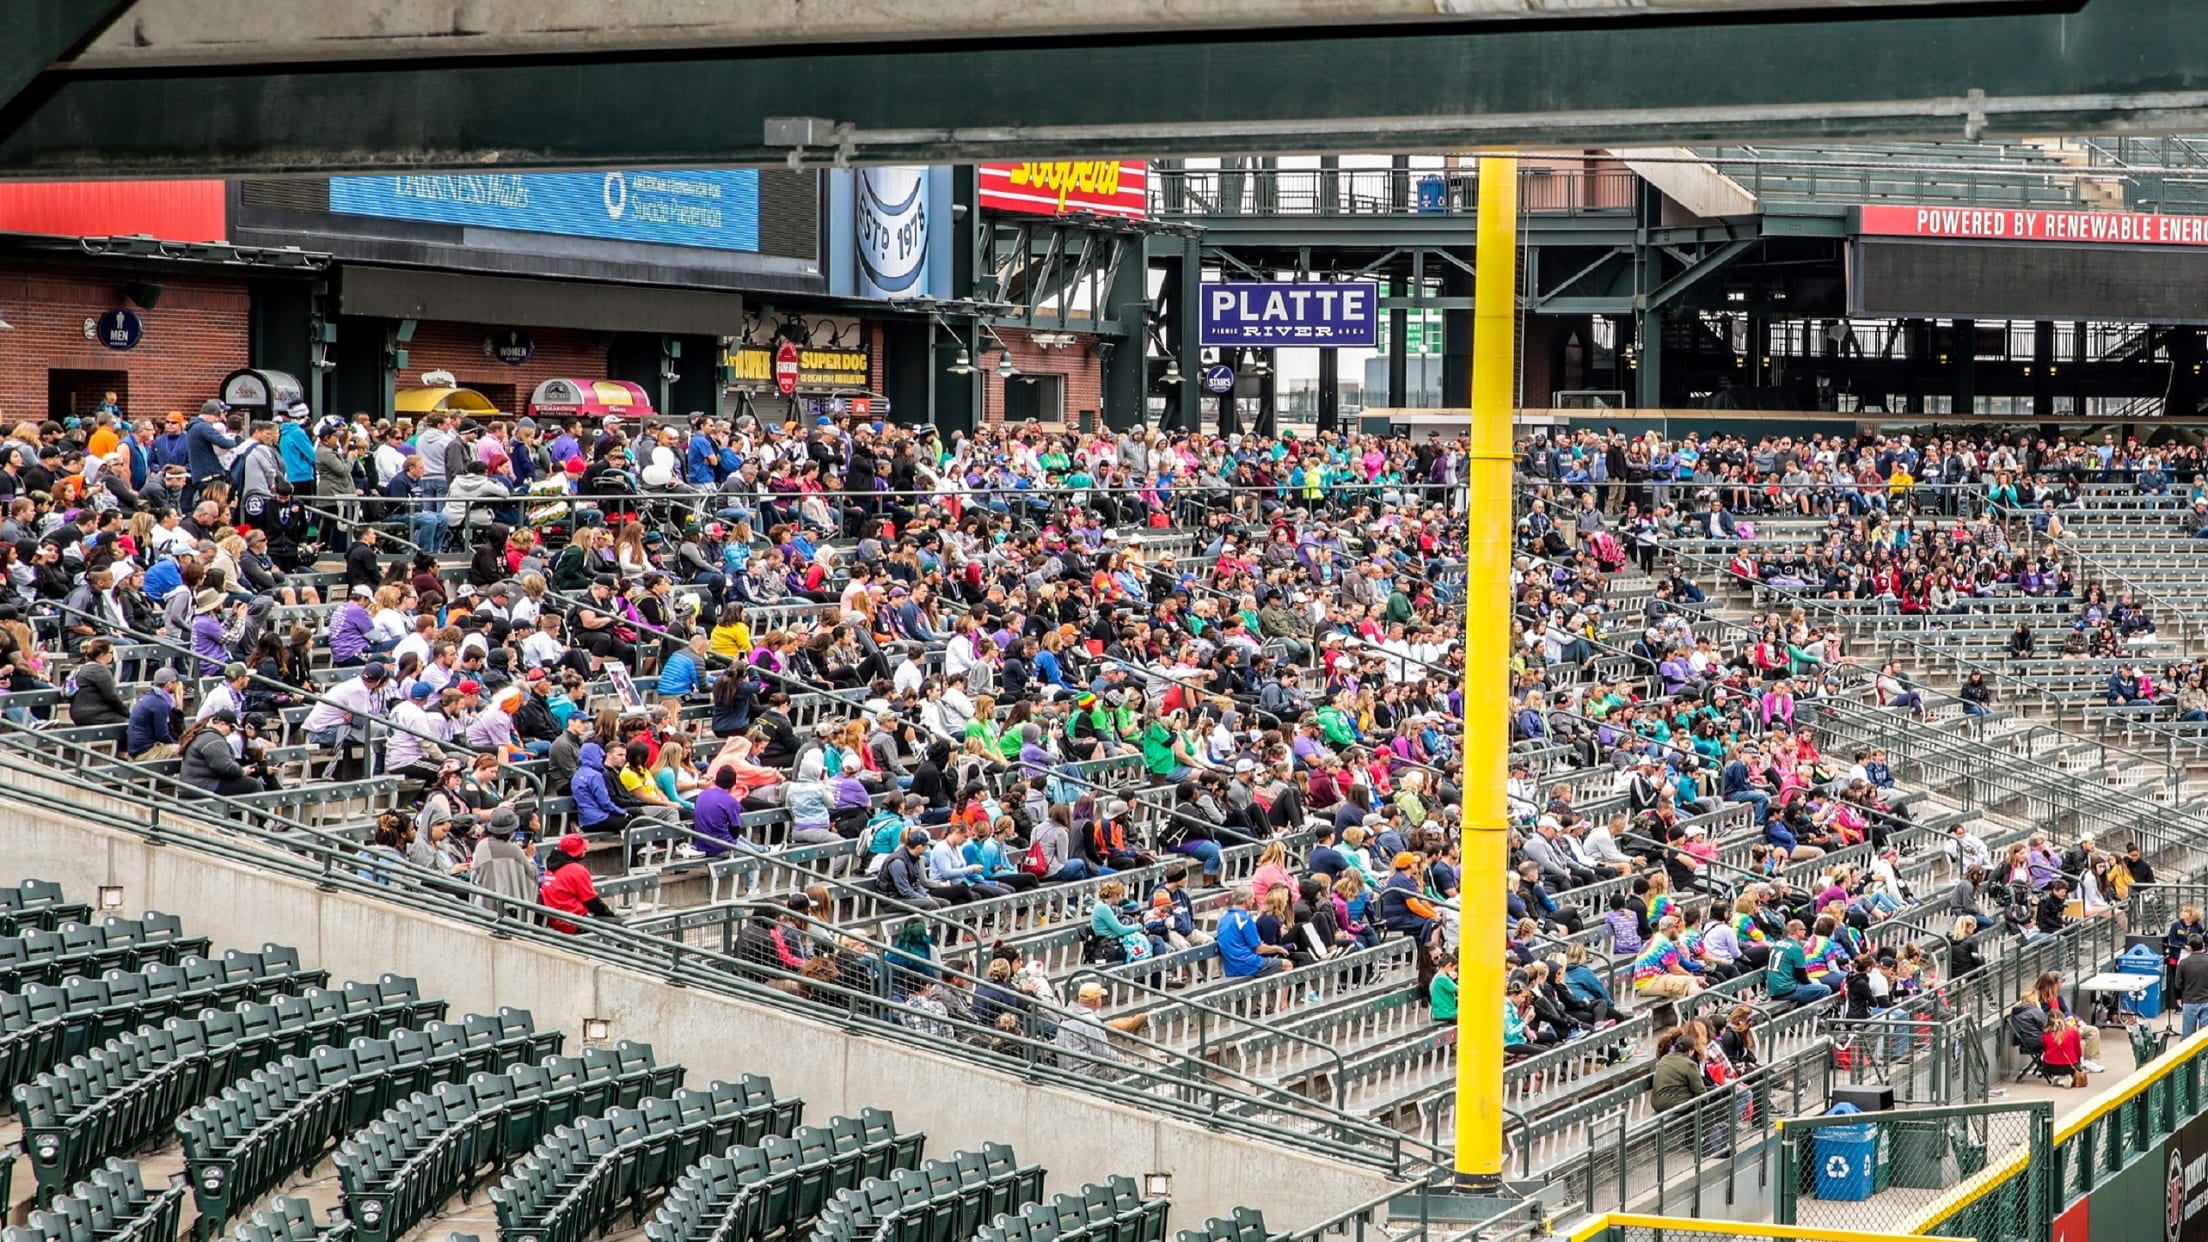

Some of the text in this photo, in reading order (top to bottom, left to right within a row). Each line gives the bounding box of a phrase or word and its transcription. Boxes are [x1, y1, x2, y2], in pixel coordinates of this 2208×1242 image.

[631, 193, 722, 228] Suicide Prevention
[897, 201, 925, 260] 1978
[1917, 209, 2005, 235] POWERED
[2013, 212, 2038, 237] BY
[2045, 213, 2151, 241] RENEWABLE
[1212, 291, 1364, 321] PLATTE
[110, 329, 129, 341] MEN
[1243, 326, 1334, 337] RIVER
[500, 347, 527, 357] WOMEN
[801, 351, 868, 371] SUPER DOG
[1208, 377, 1231, 387] STAIRS
[1768, 949, 1784, 971] 11
